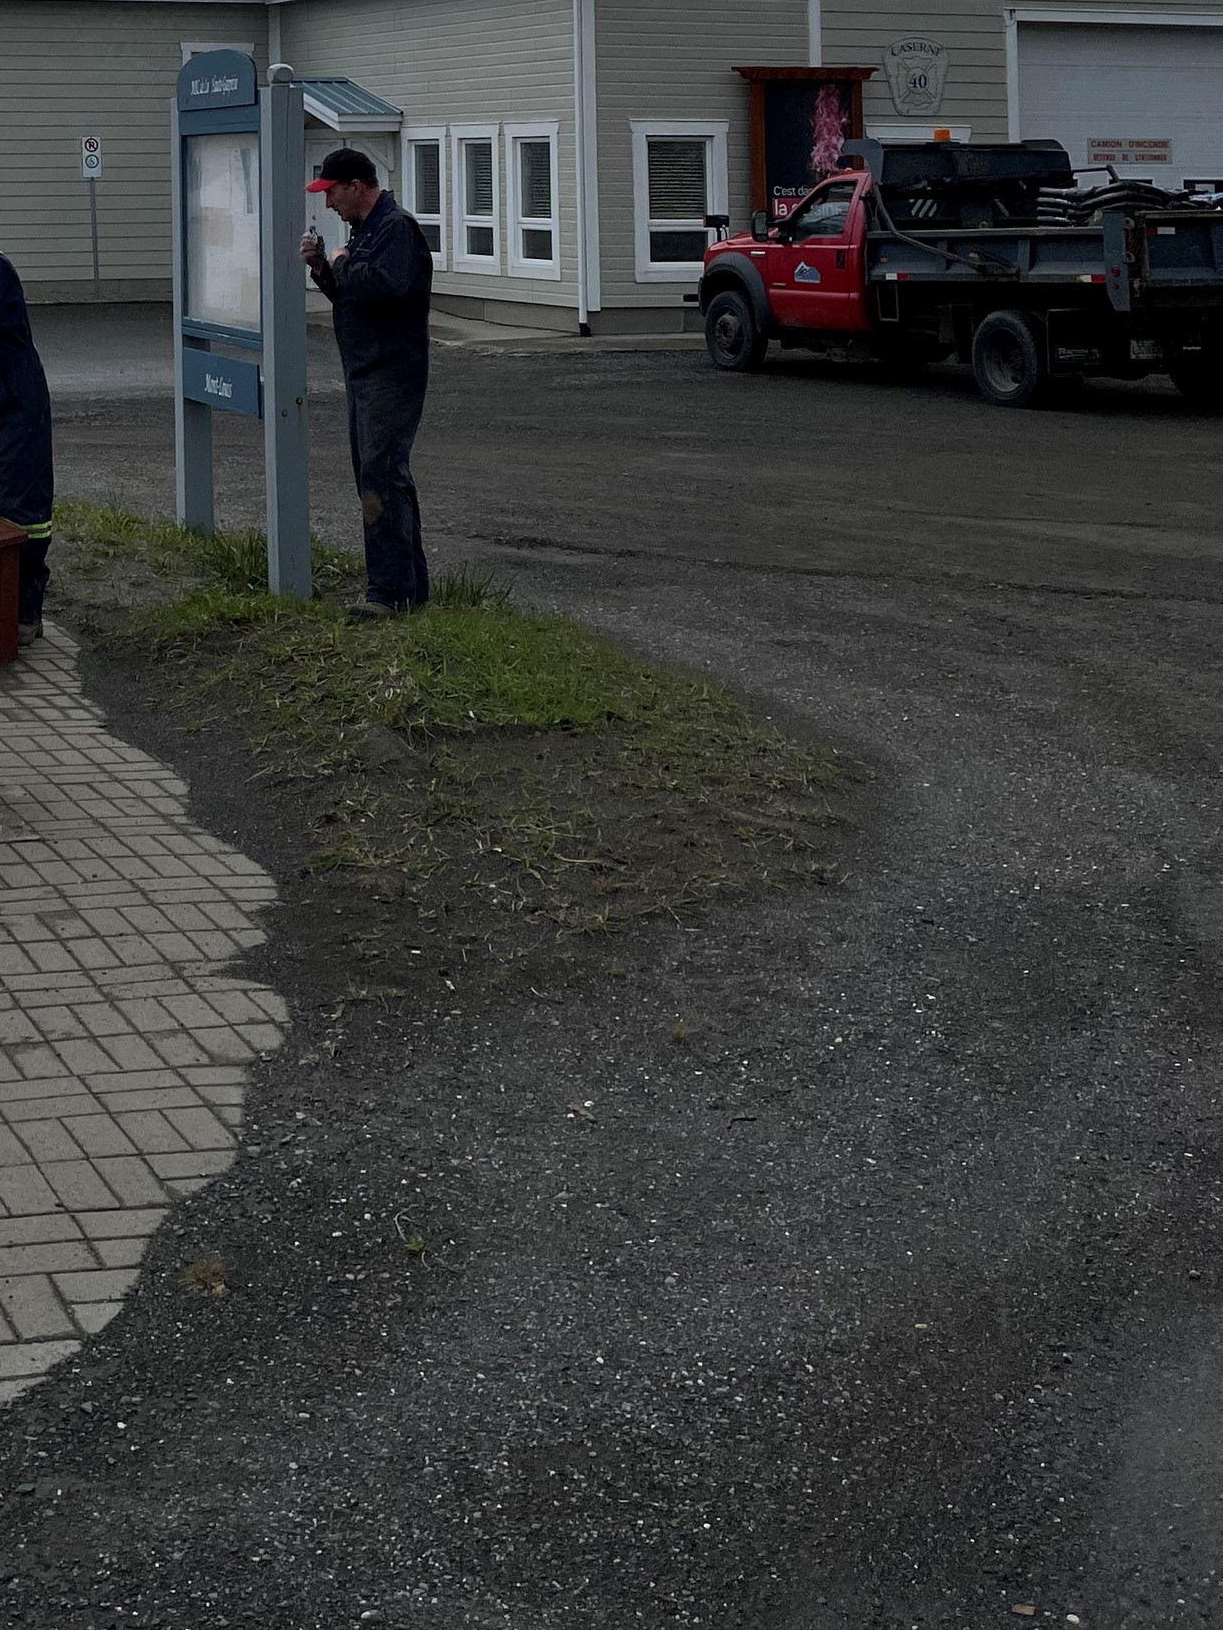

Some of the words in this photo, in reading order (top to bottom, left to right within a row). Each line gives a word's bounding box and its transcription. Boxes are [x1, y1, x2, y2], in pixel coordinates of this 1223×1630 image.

[909, 73, 927, 89] 40
[1091, 140, 1122, 148] CAMION
[774, 198, 788, 216] la
